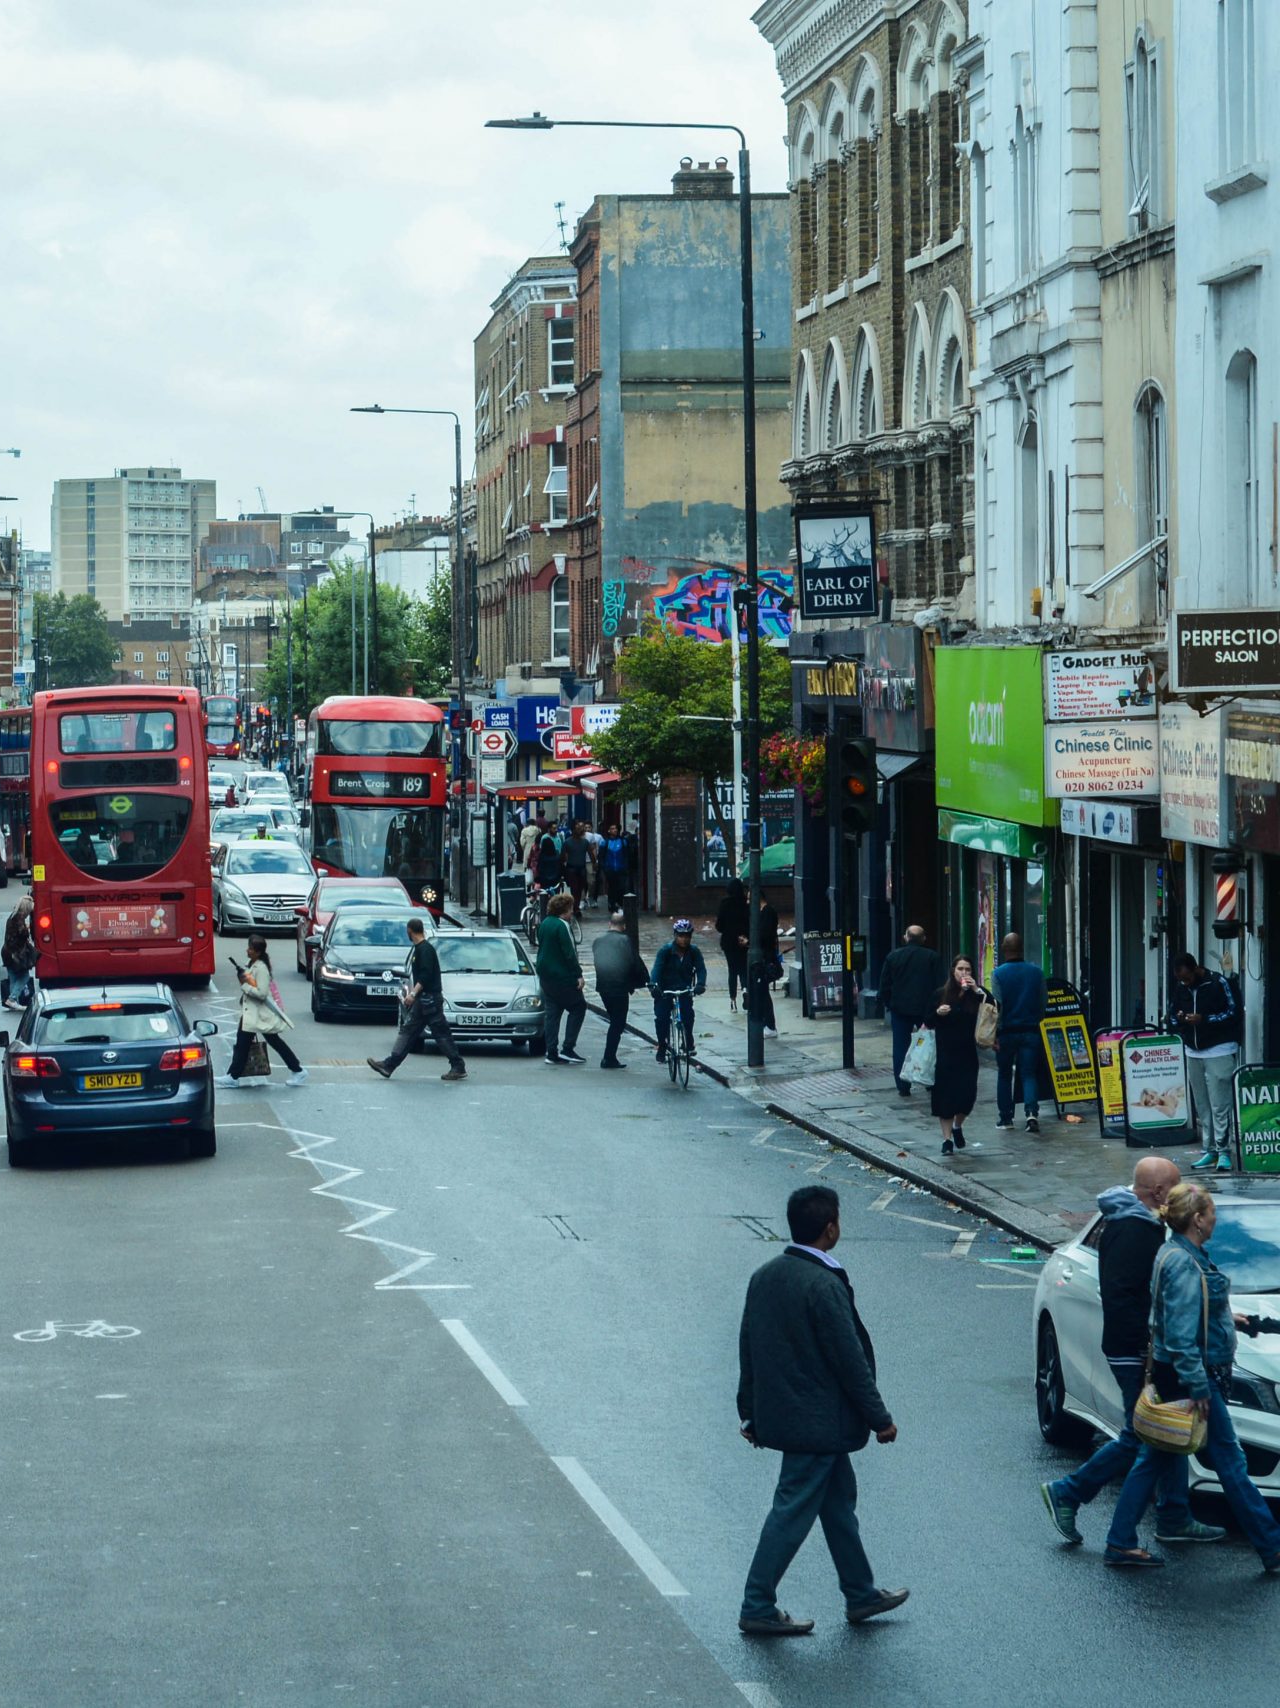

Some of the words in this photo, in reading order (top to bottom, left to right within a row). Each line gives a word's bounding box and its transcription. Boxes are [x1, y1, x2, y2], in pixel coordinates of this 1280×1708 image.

[806, 577, 845, 591] EARL
[849, 575, 871, 589] OF
[813, 592, 864, 607] DERBY
[1181, 629, 1280, 648] PERFECTIO
[1063, 656, 1116, 669] GADGET
[1120, 654, 1149, 667] HUB
[1215, 650, 1259, 663] SALON
[535, 706, 560, 724] H&
[475, 721, 481, 731] J
[1080, 729, 1106, 737] Health
[1108, 728, 1126, 737] Plus
[1055, 739, 1110, 753] Chinese
[1113, 737, 1153, 751] Clinic
[1078, 757, 1131, 767] Acupuncture
[1055, 769, 1086, 779] Chinese
[1088, 768, 1121, 779] Massage
[1122, 767, 1138, 777] (Tui
[1140, 767, 1155, 777] Na)
[338, 778, 361, 788] Brent
[364, 779, 390, 788] Cross
[403, 778, 423, 792] 189
[1065, 782, 1085, 792] 020
[1088, 781, 1114, 791] 8062
[1117, 780, 1144, 790] 0234
[820, 944, 825, 954] 2
[826, 944, 842, 953] FOR
[462, 1015, 483, 1024] X923
[1144, 1048, 1172, 1057] CHINESE
[1164, 1055, 1180, 1063] CLINIC
[116, 1074, 138, 1086] YZD
[1056, 1073, 1065, 1082] 20
[1066, 1071, 1094, 1081] MINUTE
